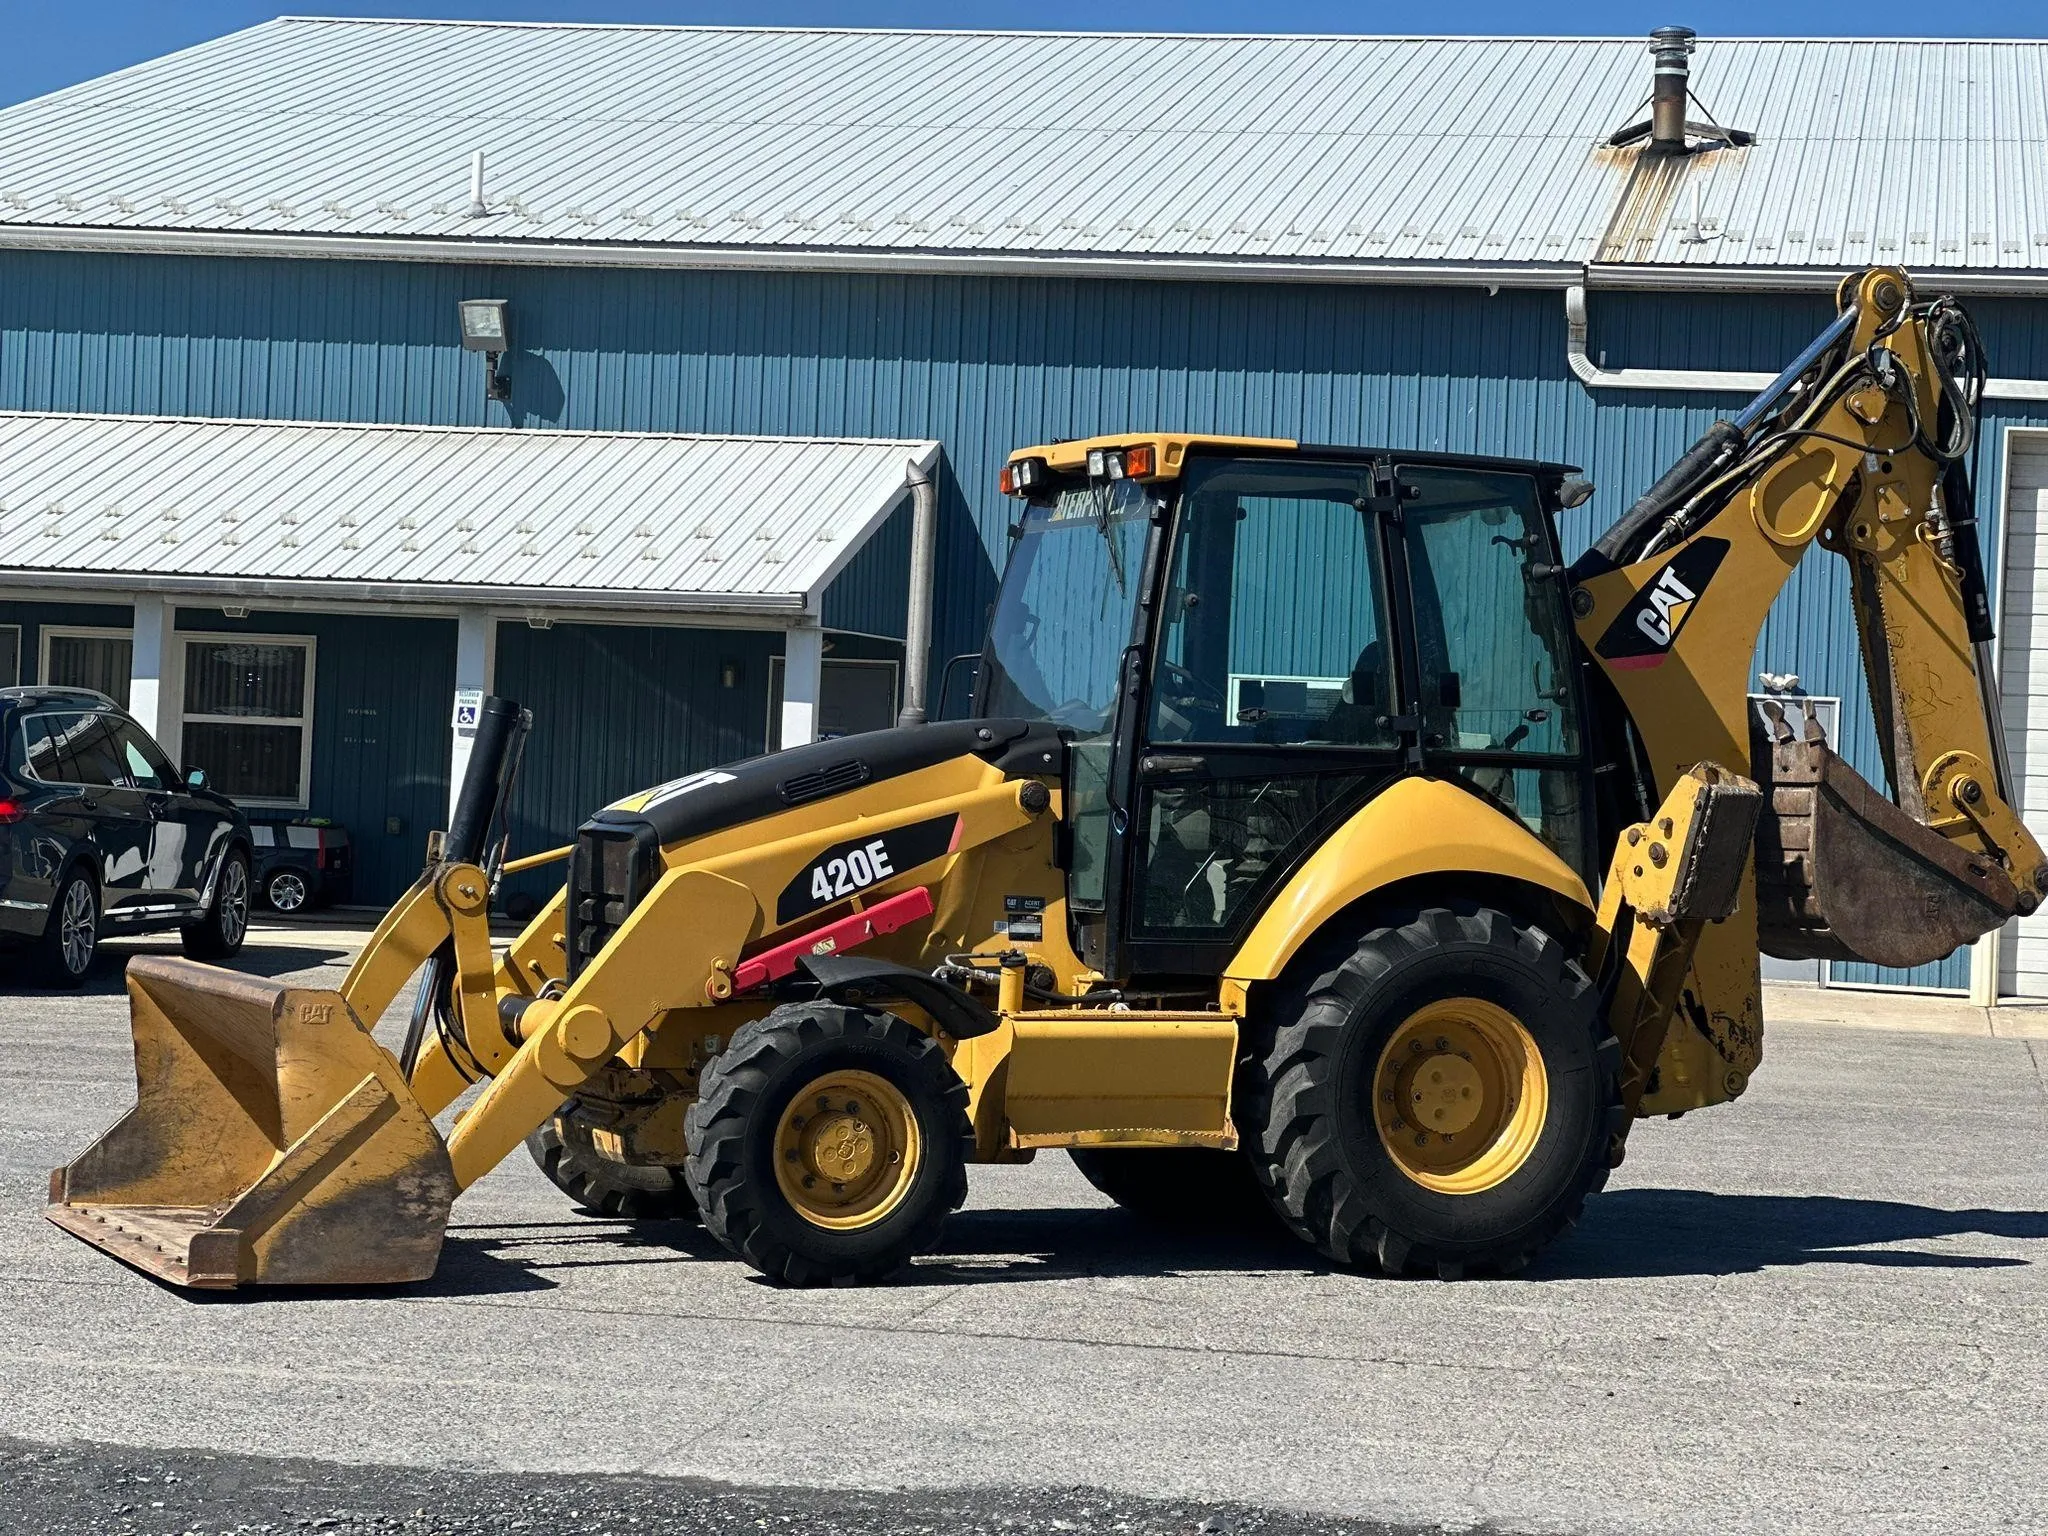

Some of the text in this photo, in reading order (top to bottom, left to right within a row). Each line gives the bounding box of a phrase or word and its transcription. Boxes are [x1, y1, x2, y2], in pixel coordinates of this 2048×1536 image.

[1636, 565, 1696, 646] CAT
[602, 771, 738, 814] AT
[811, 839, 894, 902] 420E
[1006, 898, 1018, 906] CAT
[299, 1003, 334, 1025] CAT
